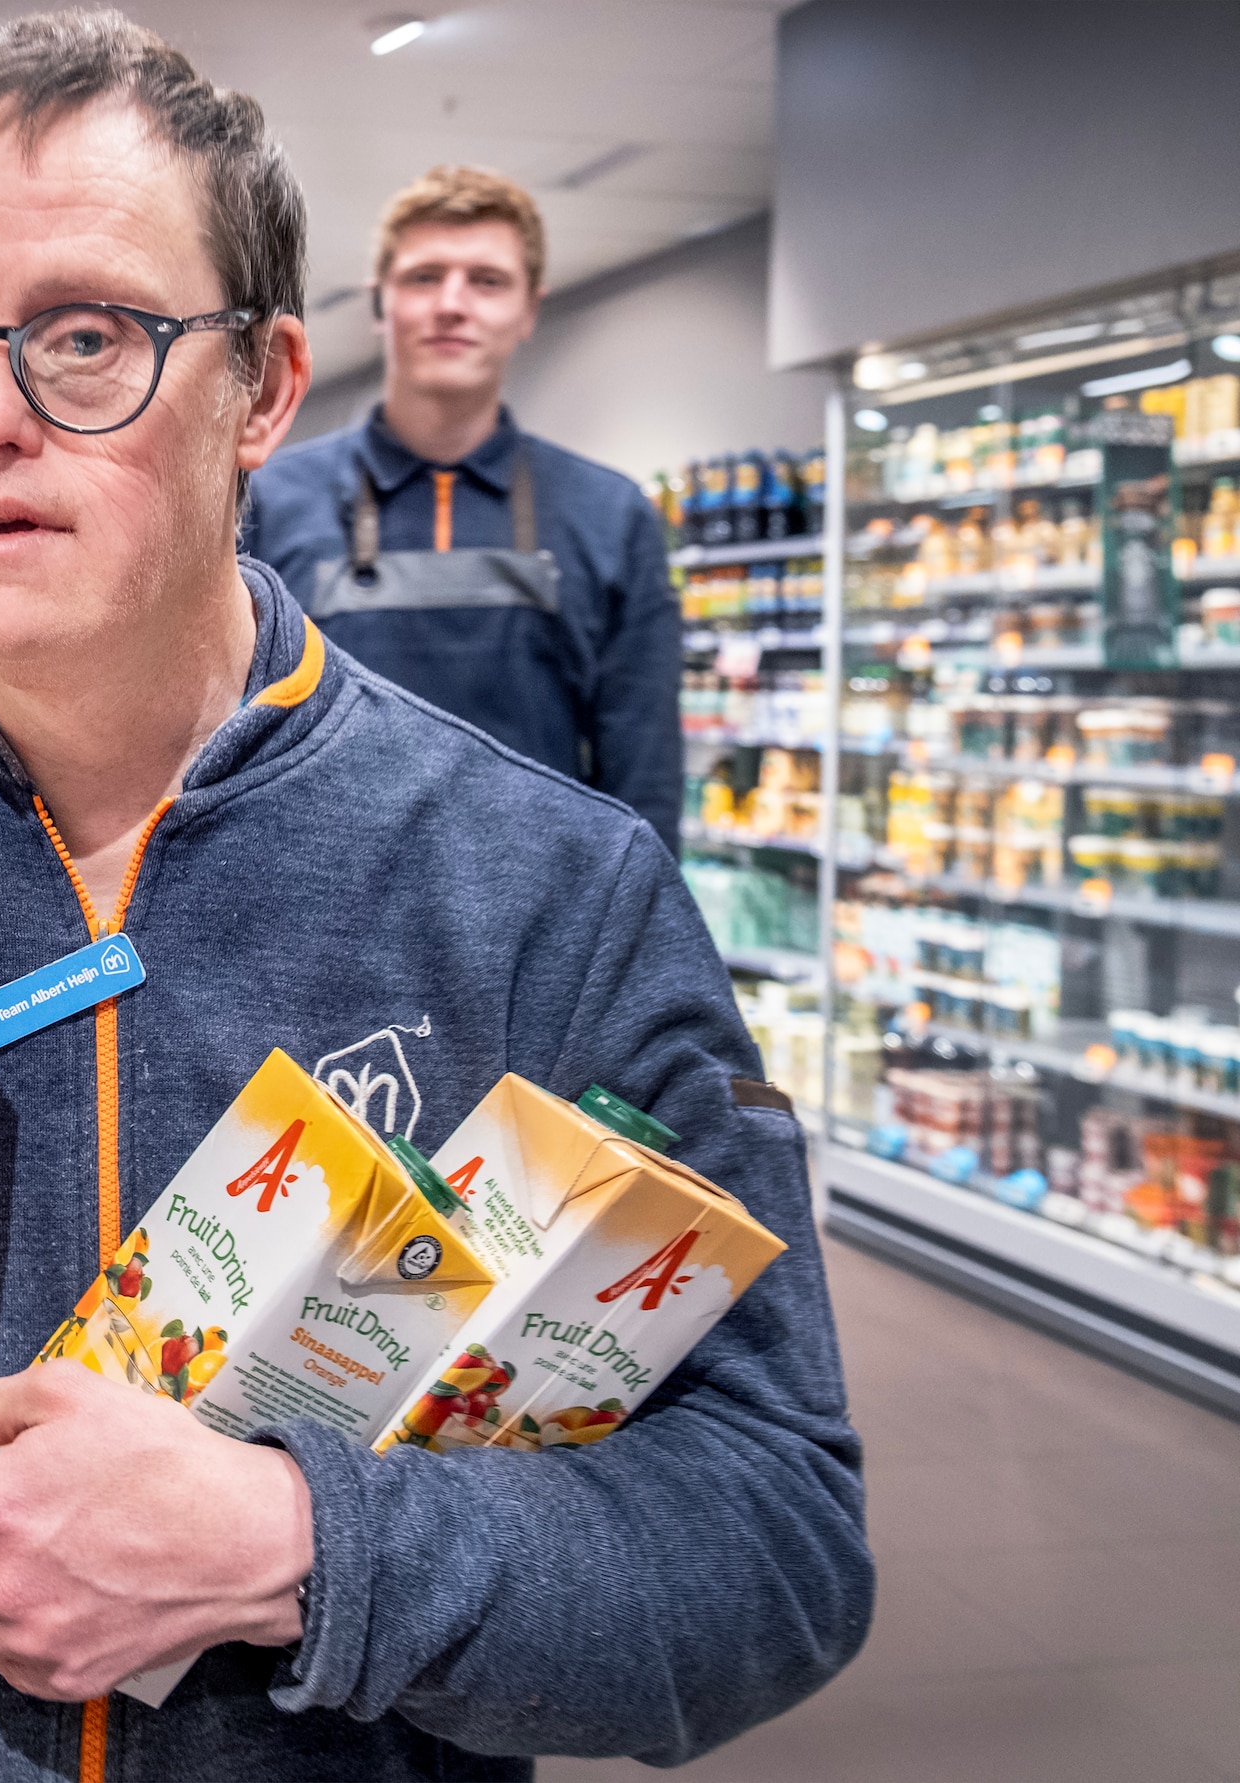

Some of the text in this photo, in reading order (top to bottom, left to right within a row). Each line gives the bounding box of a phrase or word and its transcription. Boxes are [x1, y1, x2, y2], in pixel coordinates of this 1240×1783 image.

[30, 980, 68, 1006] Albert
[67, 967, 99, 989] Heijn
[170, 1249, 212, 1304] pointe de lait
[187, 1245, 216, 1283] avec une
[289, 1326, 386, 1386] Sinaasappel
[303, 1358, 347, 1387] Orange
